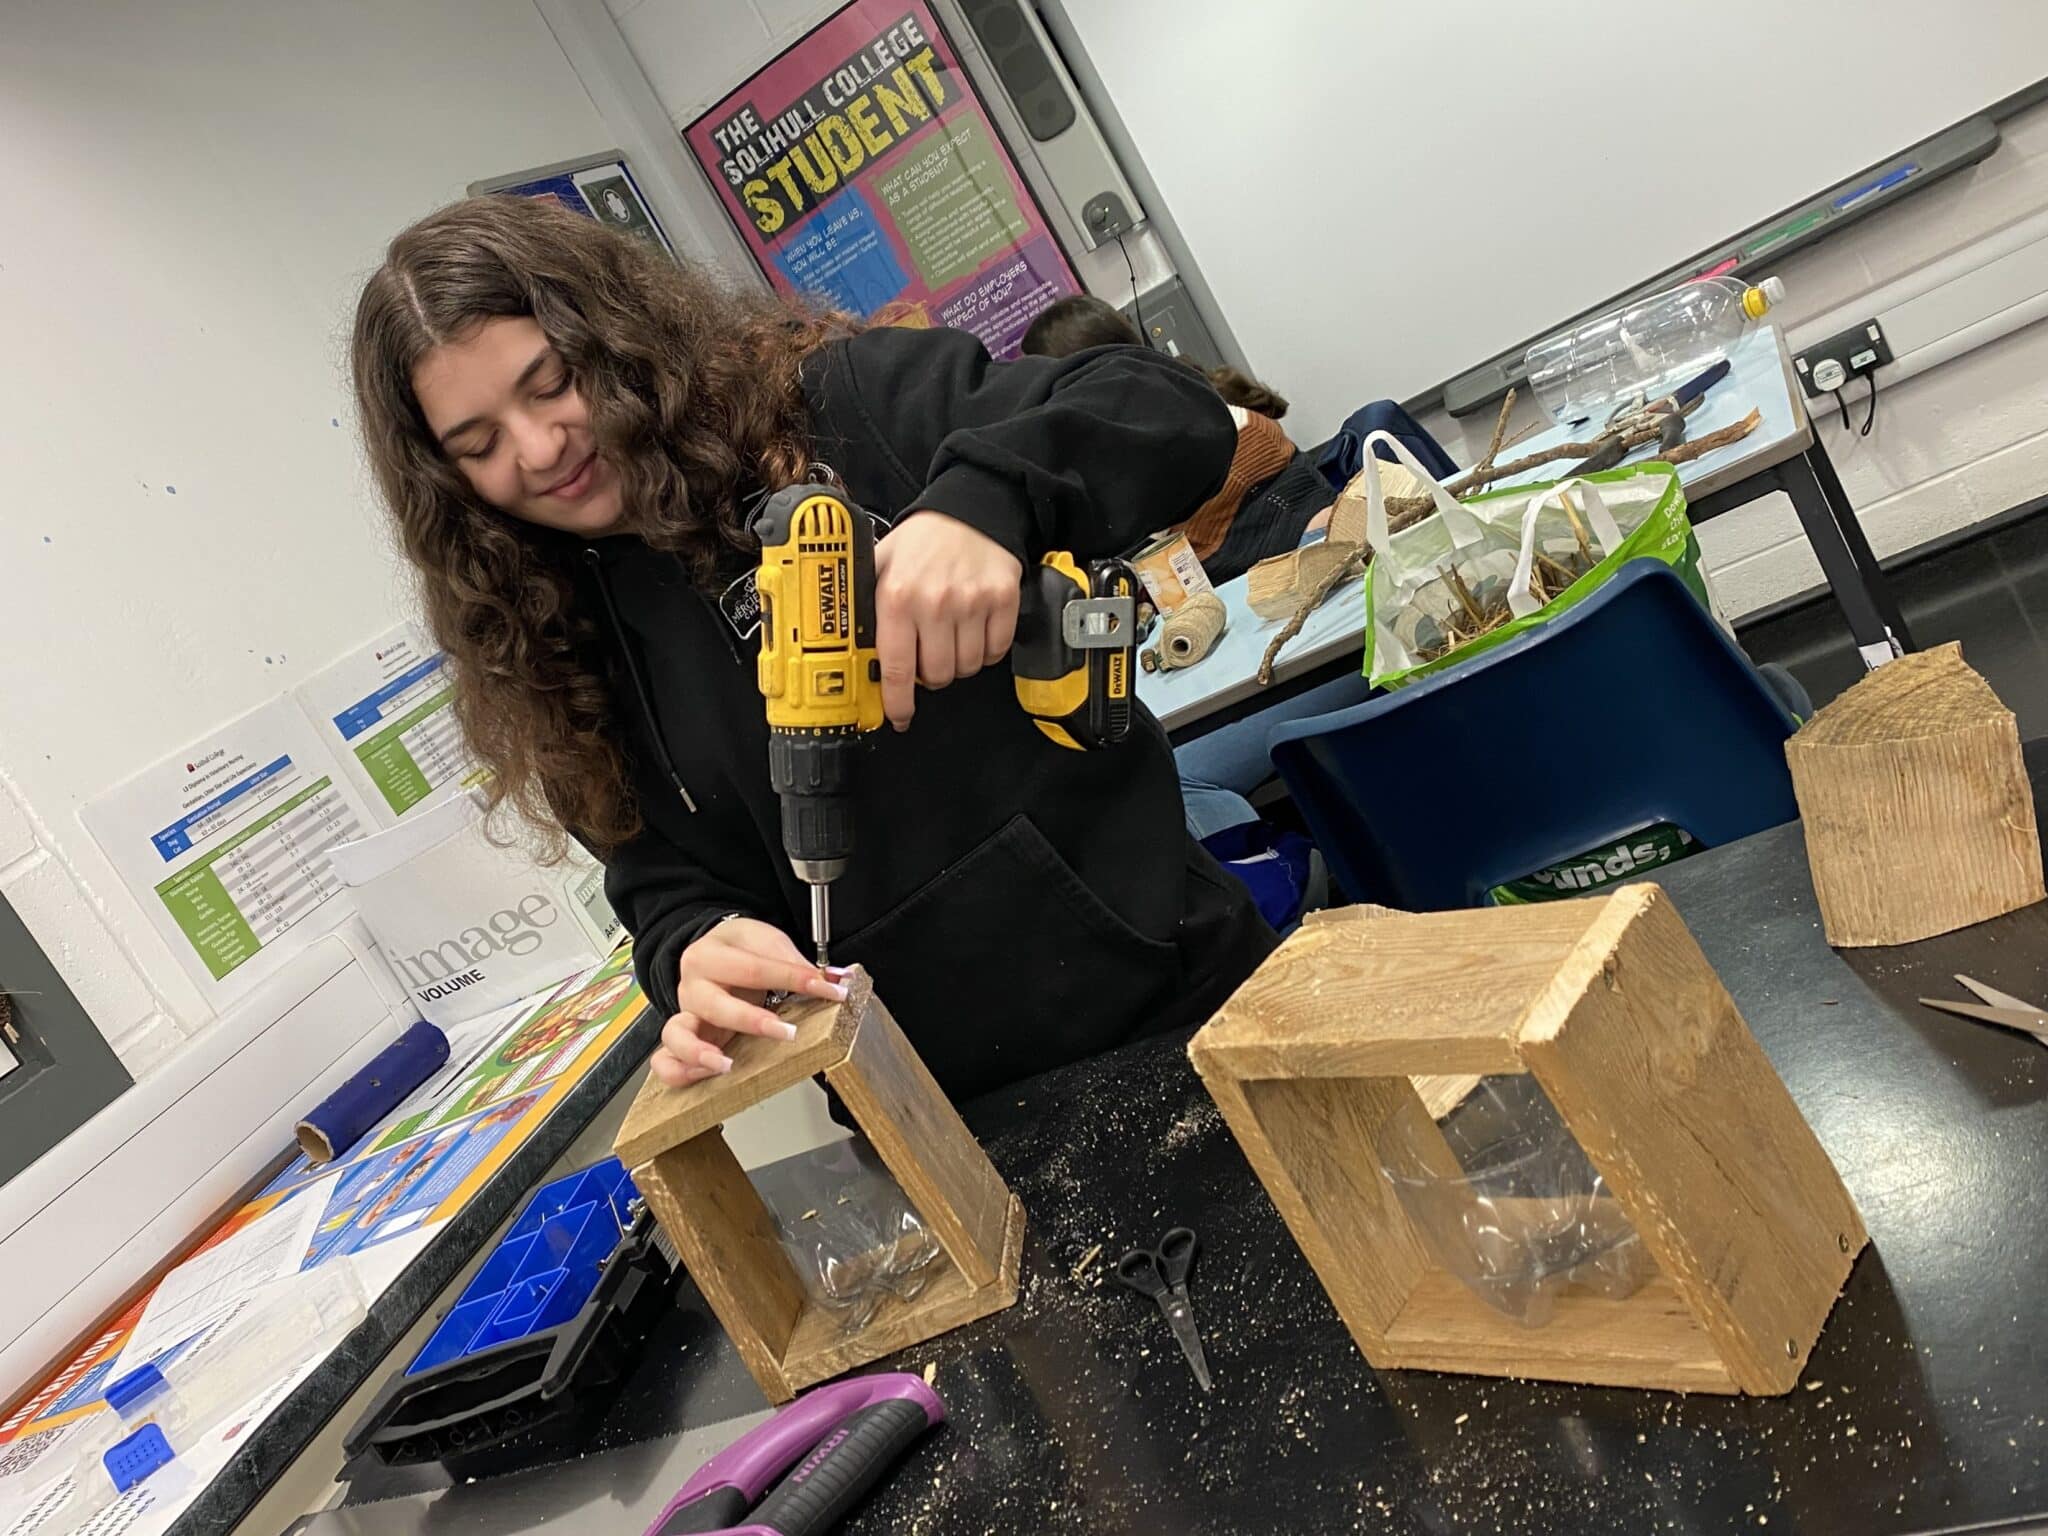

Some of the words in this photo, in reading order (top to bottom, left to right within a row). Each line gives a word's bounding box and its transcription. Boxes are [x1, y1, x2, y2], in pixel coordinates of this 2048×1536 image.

[723, 99, 826, 185] SOLIHULL
[822, 17, 925, 107] COLLEGE
[716, 108, 761, 153] THE
[742, 47, 945, 233] STUDENT
[881, 173, 903, 196] WHAT
[903, 162, 922, 180] CAN
[921, 150, 940, 167] YOU
[939, 128, 972, 154] EXPECT
[888, 187, 902, 208] AS
[900, 186, 909, 196] A
[909, 158, 950, 190] STUDENT?
[785, 244, 806, 262] WHEN
[805, 233, 822, 249] YOU
[822, 215, 848, 236] LEAVE
[790, 258, 807, 273] YOU
[806, 245, 825, 262] WILL
[941, 301, 963, 320] WHAT
[963, 291, 977, 306] DO
[979, 261, 1025, 296] EMPLOYERS
[948, 306, 977, 330] EXPECT
[977, 297, 991, 311] OF
[991, 283, 1014, 302] YOU?
[390, 894, 558, 988] image
[418, 968, 486, 1003] VOLUME
[792, 1429, 850, 1482] IRWIN
